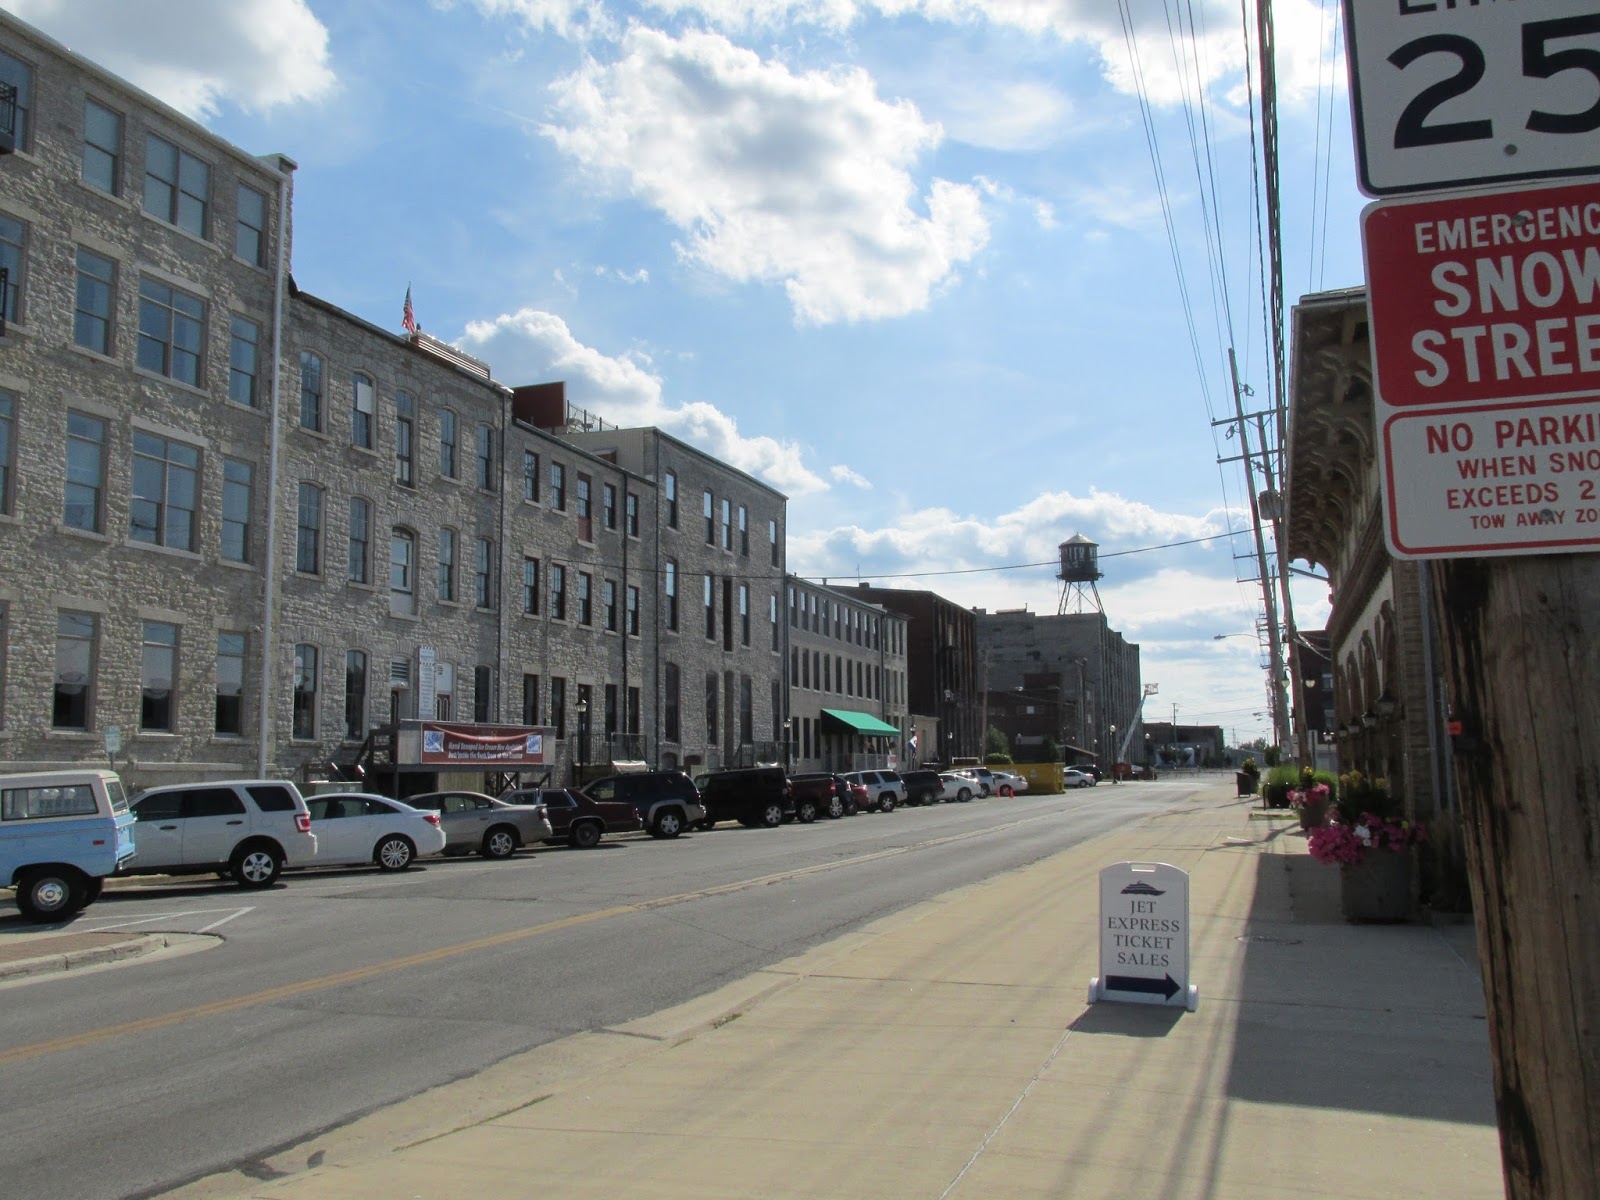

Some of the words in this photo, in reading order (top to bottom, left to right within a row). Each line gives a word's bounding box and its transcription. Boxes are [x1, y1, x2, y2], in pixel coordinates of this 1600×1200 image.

[1386, 13, 1600, 149] 25
[1411, 313, 1600, 387] STREE
[1425, 422, 1473, 454] NO
[1495, 412, 1600, 449] PARKI
[1456, 455, 1536, 479] WHEN
[1549, 449, 1600, 473] SNO
[1446, 482, 1559, 509] EXCEEDS
[1578, 480, 1596, 500] 2
[1470, 513, 1506, 529] TOW
[1575, 507, 1600, 523] ZO
[1130, 900, 1157, 915] JET
[1107, 917, 1180, 932] EXPRESS
[1113, 934, 1174, 950] TICKET
[1117, 952, 1169, 967] SALES
